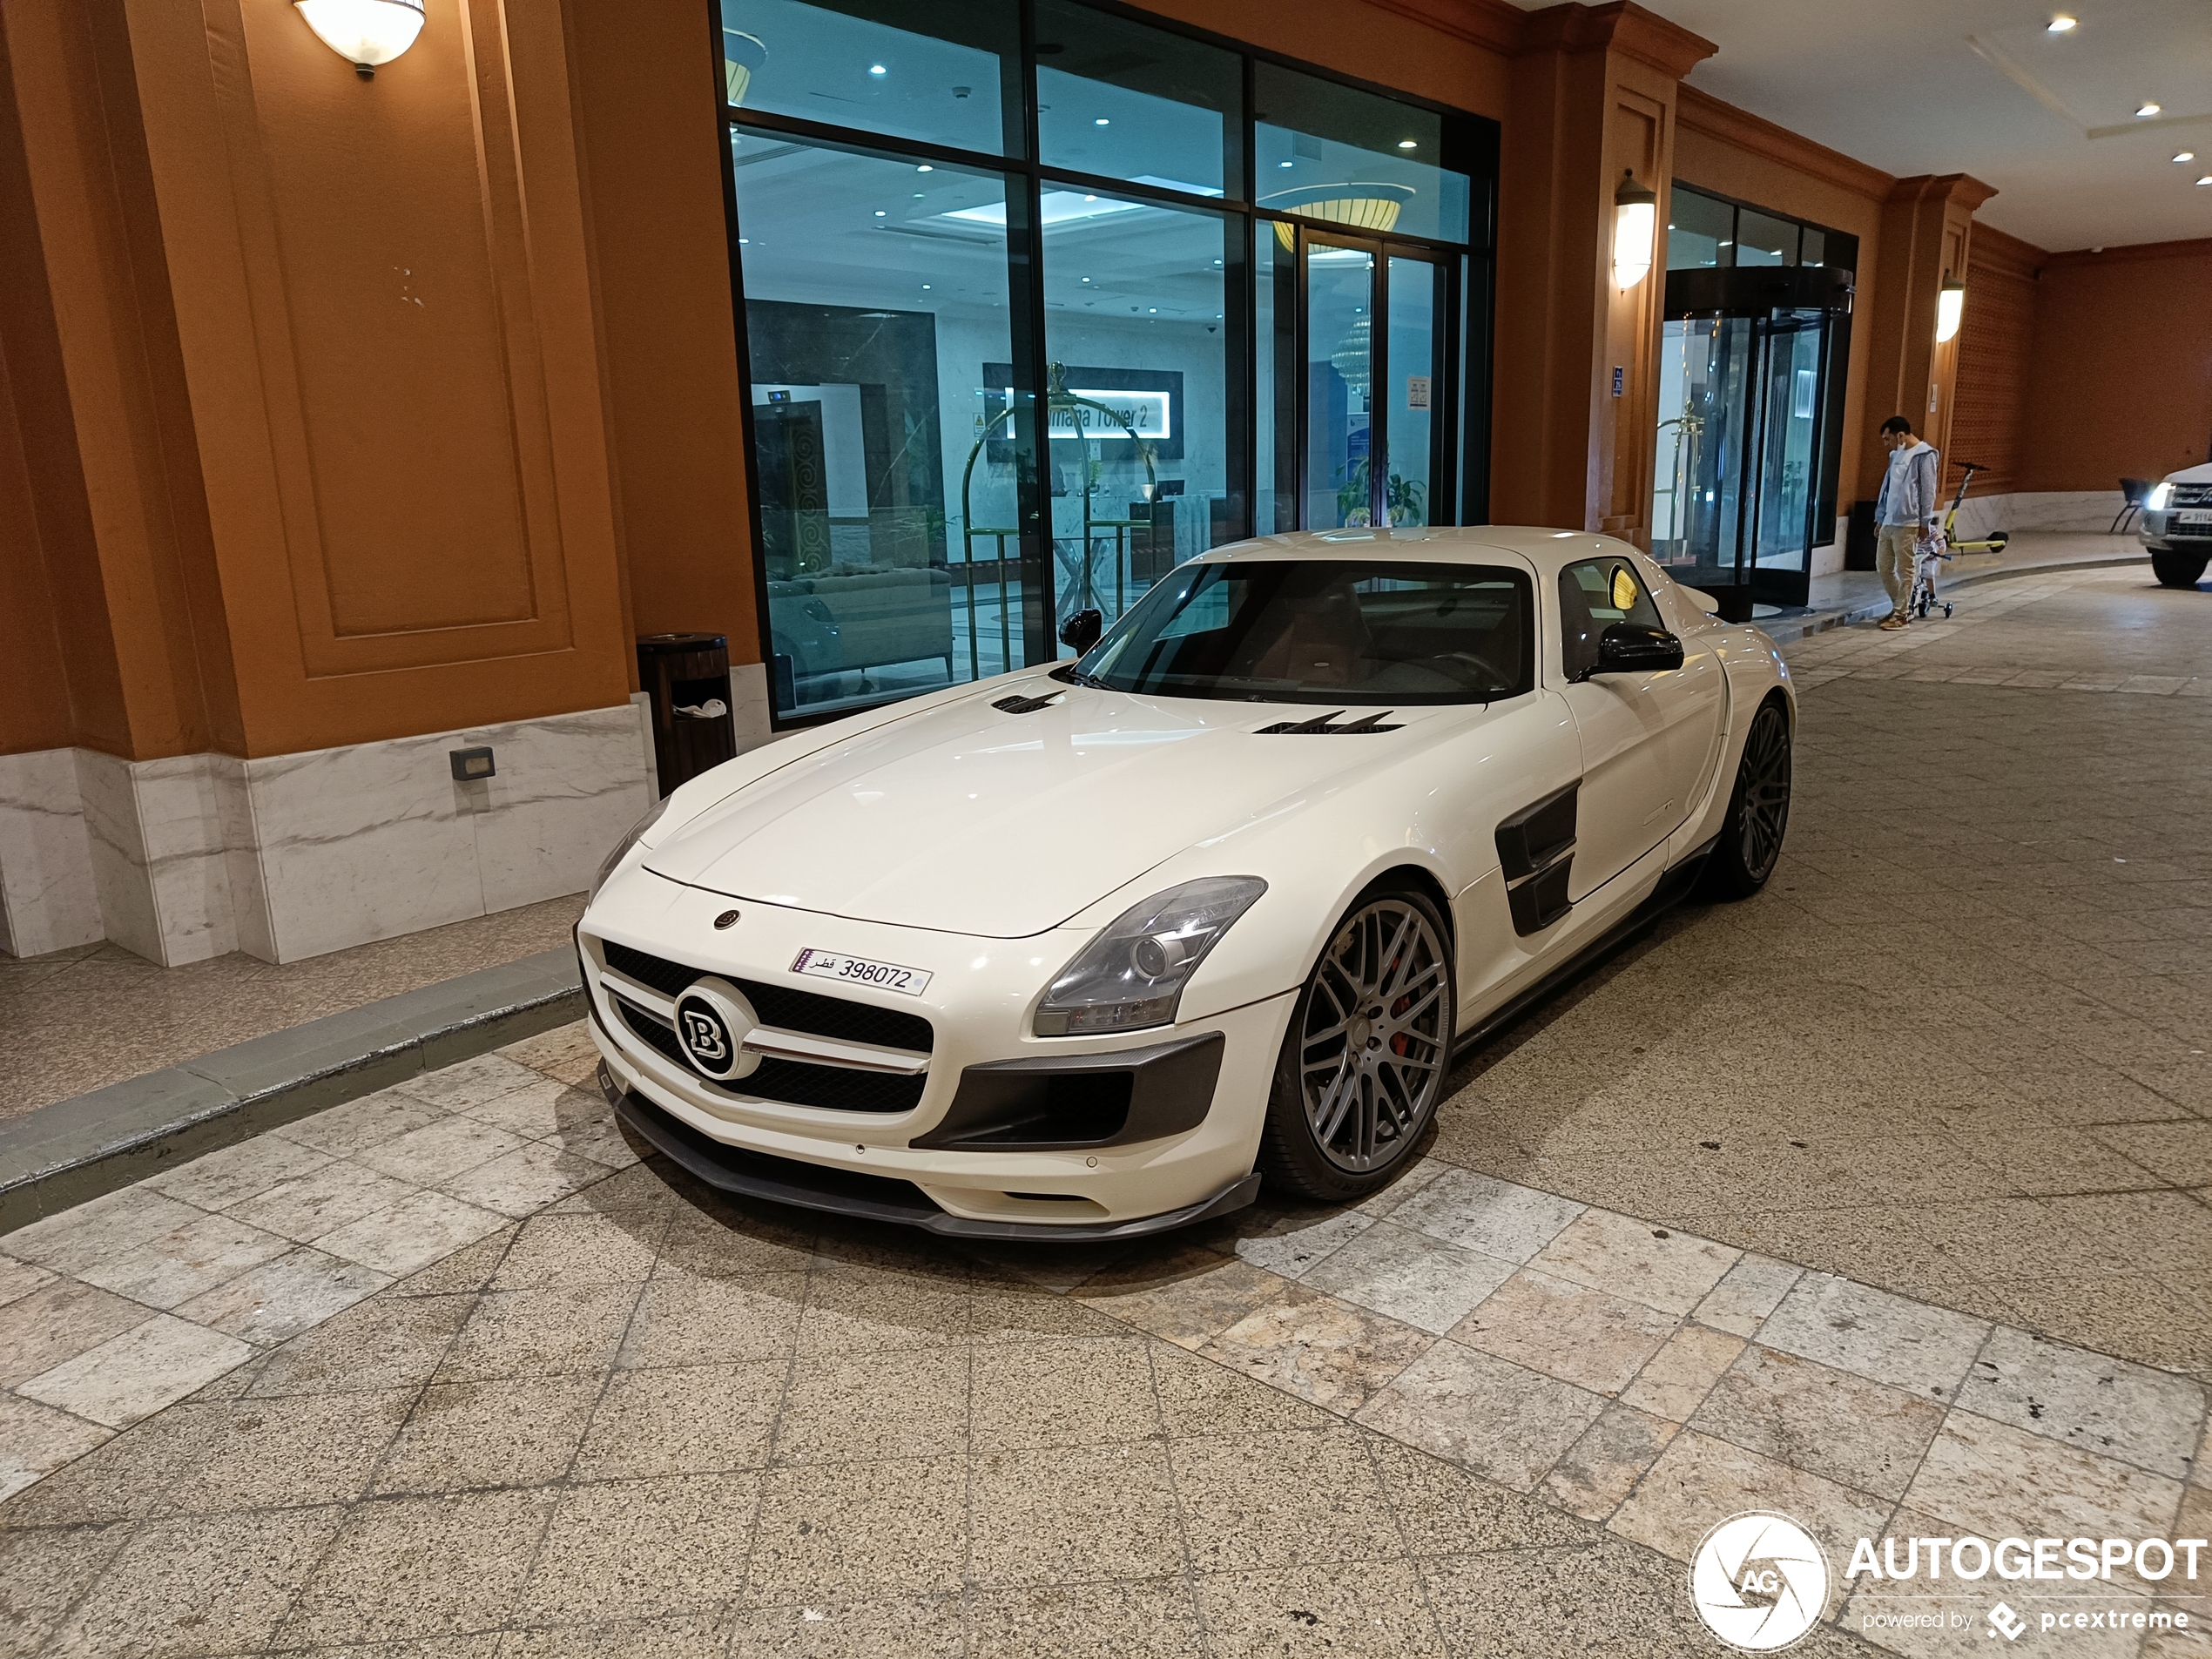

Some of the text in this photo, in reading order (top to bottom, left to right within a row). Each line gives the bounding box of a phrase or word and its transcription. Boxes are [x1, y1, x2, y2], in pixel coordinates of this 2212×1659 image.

[1049, 408, 1090, 428] mana
[1139, 404, 1148, 428] 2
[794, 950, 810, 971] QATAR
[808, 957, 837, 969] قطر
[838, 960, 913, 988] 398072
